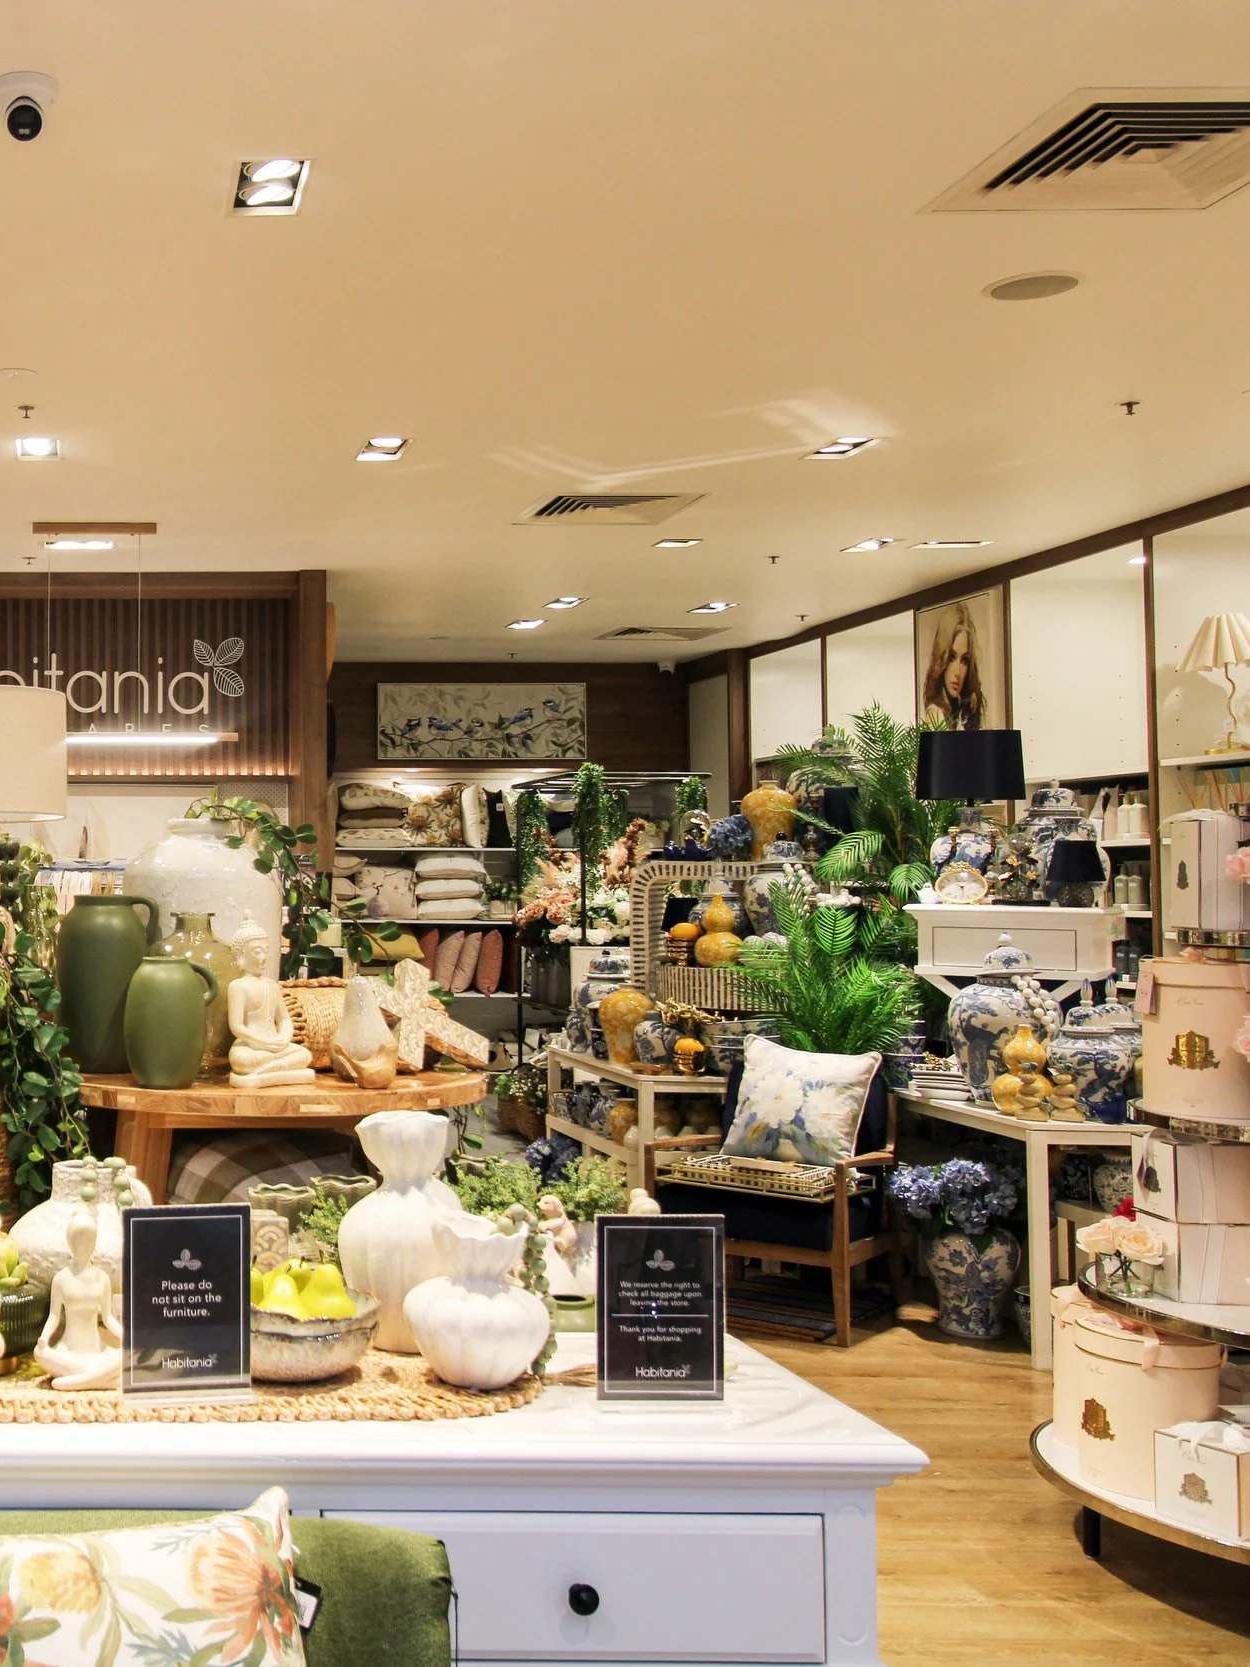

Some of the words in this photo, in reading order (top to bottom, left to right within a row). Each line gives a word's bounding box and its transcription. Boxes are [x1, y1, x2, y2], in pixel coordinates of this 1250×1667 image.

[161, 1280, 195, 1291] Please
[198, 1279, 213, 1290] do
[619, 1280, 631, 1288] We
[673, 1281, 691, 1290] right
[151, 1295, 170, 1305] not
[172, 1294, 185, 1304] sit
[188, 1295, 201, 1303] on
[204, 1292, 222, 1303] the
[618, 1289, 638, 1297] check
[640, 1289, 649, 1297] all
[650, 1290, 682, 1299] baggage
[683, 1291, 702, 1299] upon
[163, 1307, 210, 1318] furniture.
[619, 1325, 640, 1333] Thank
[656, 1325, 667, 1333] for
[668, 1326, 702, 1335] shopping
[646, 1334, 682, 1342] Habitania.
[161, 1357, 212, 1369] Habitania
[635, 1366, 686, 1378] Habitania
